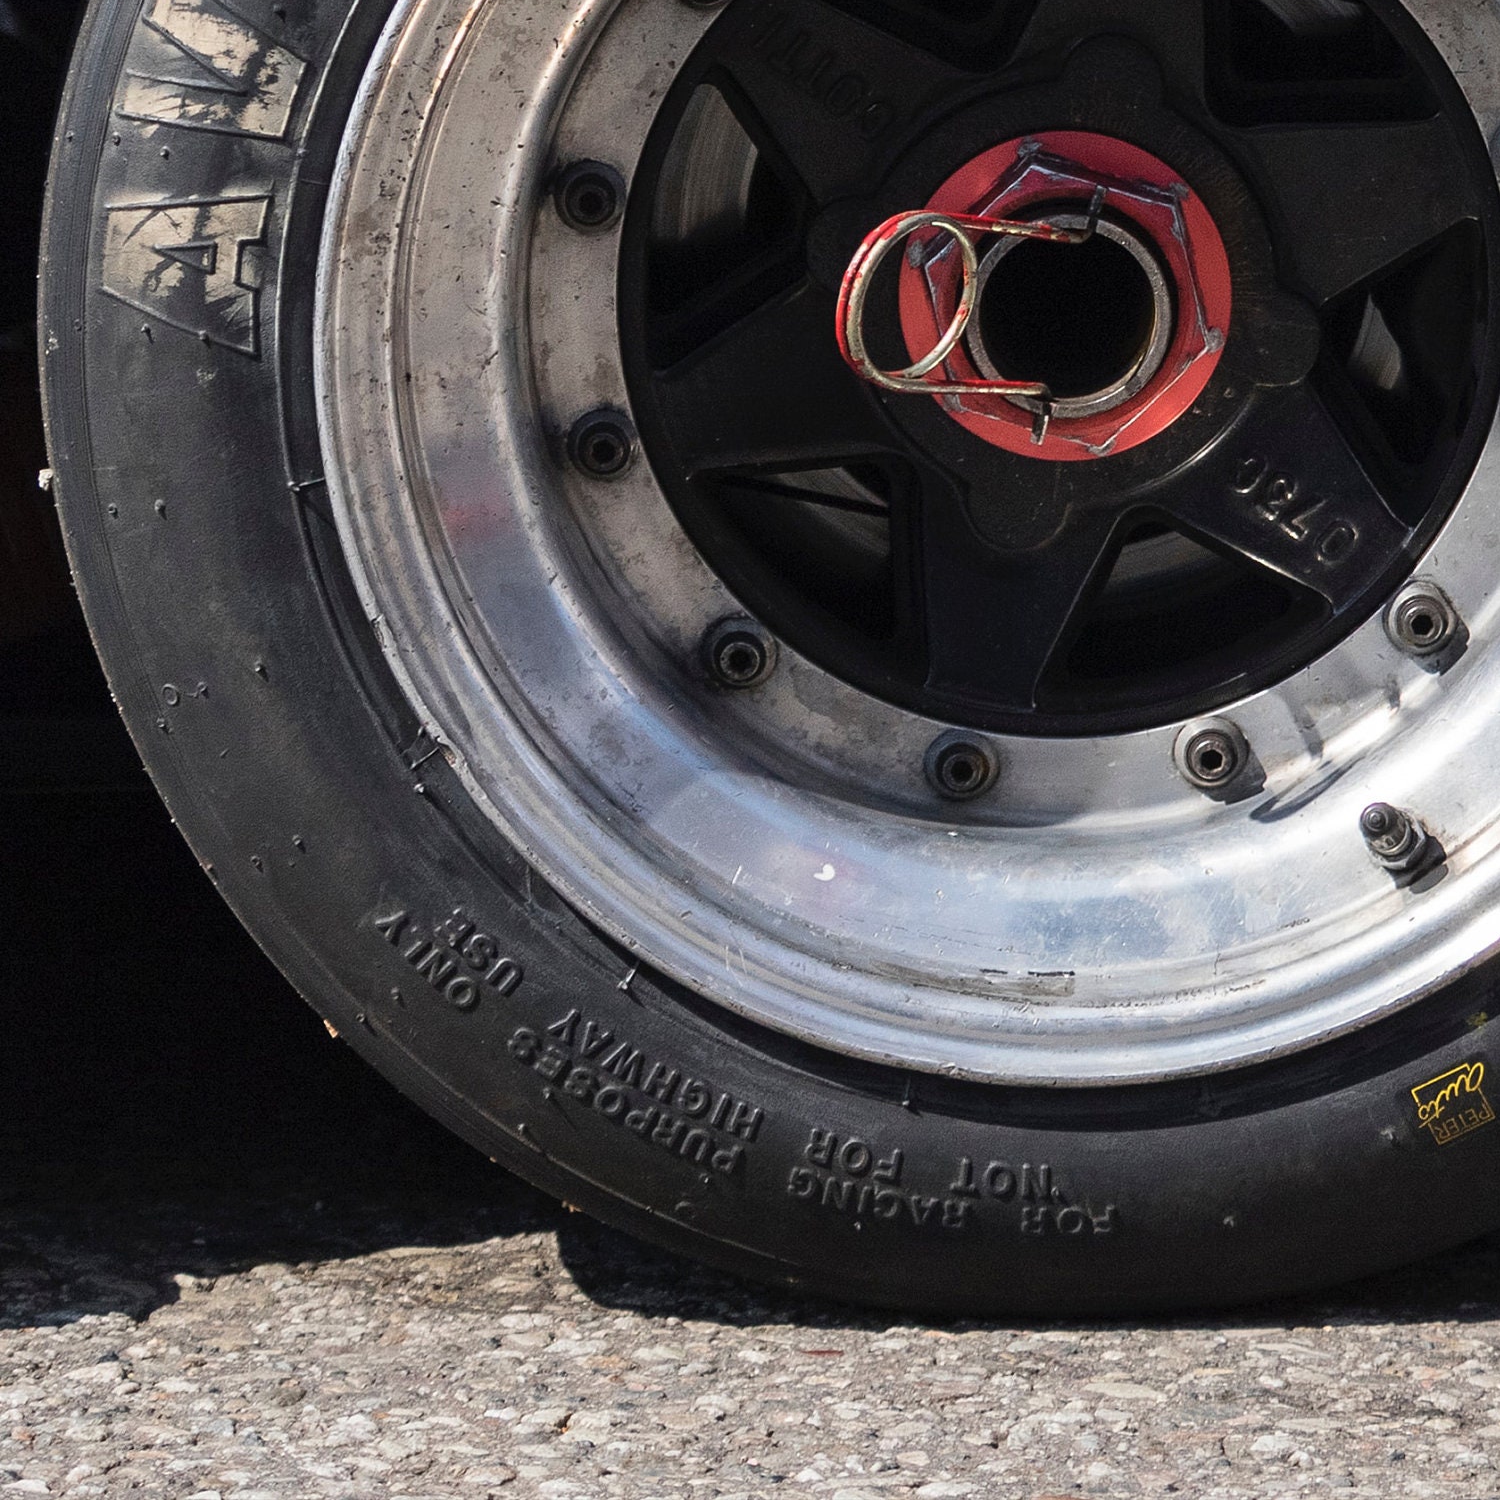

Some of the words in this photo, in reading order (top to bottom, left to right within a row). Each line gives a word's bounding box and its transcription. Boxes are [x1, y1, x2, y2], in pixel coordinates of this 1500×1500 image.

[375, 911, 479, 1010] ONLY
[433, 906, 524, 997] USE
[507, 1025, 744, 1176] PURPOSES
[546, 1009, 766, 1144] HIGHWAY
[1418, 1062, 1485, 1128] auto
[804, 1125, 905, 1182] FOR
[1434, 1106, 1491, 1141] PETER
[788, 1167, 972, 1229] RACING
[949, 1156, 1054, 1198] NOT
[1019, 1203, 1119, 1235] FOR
